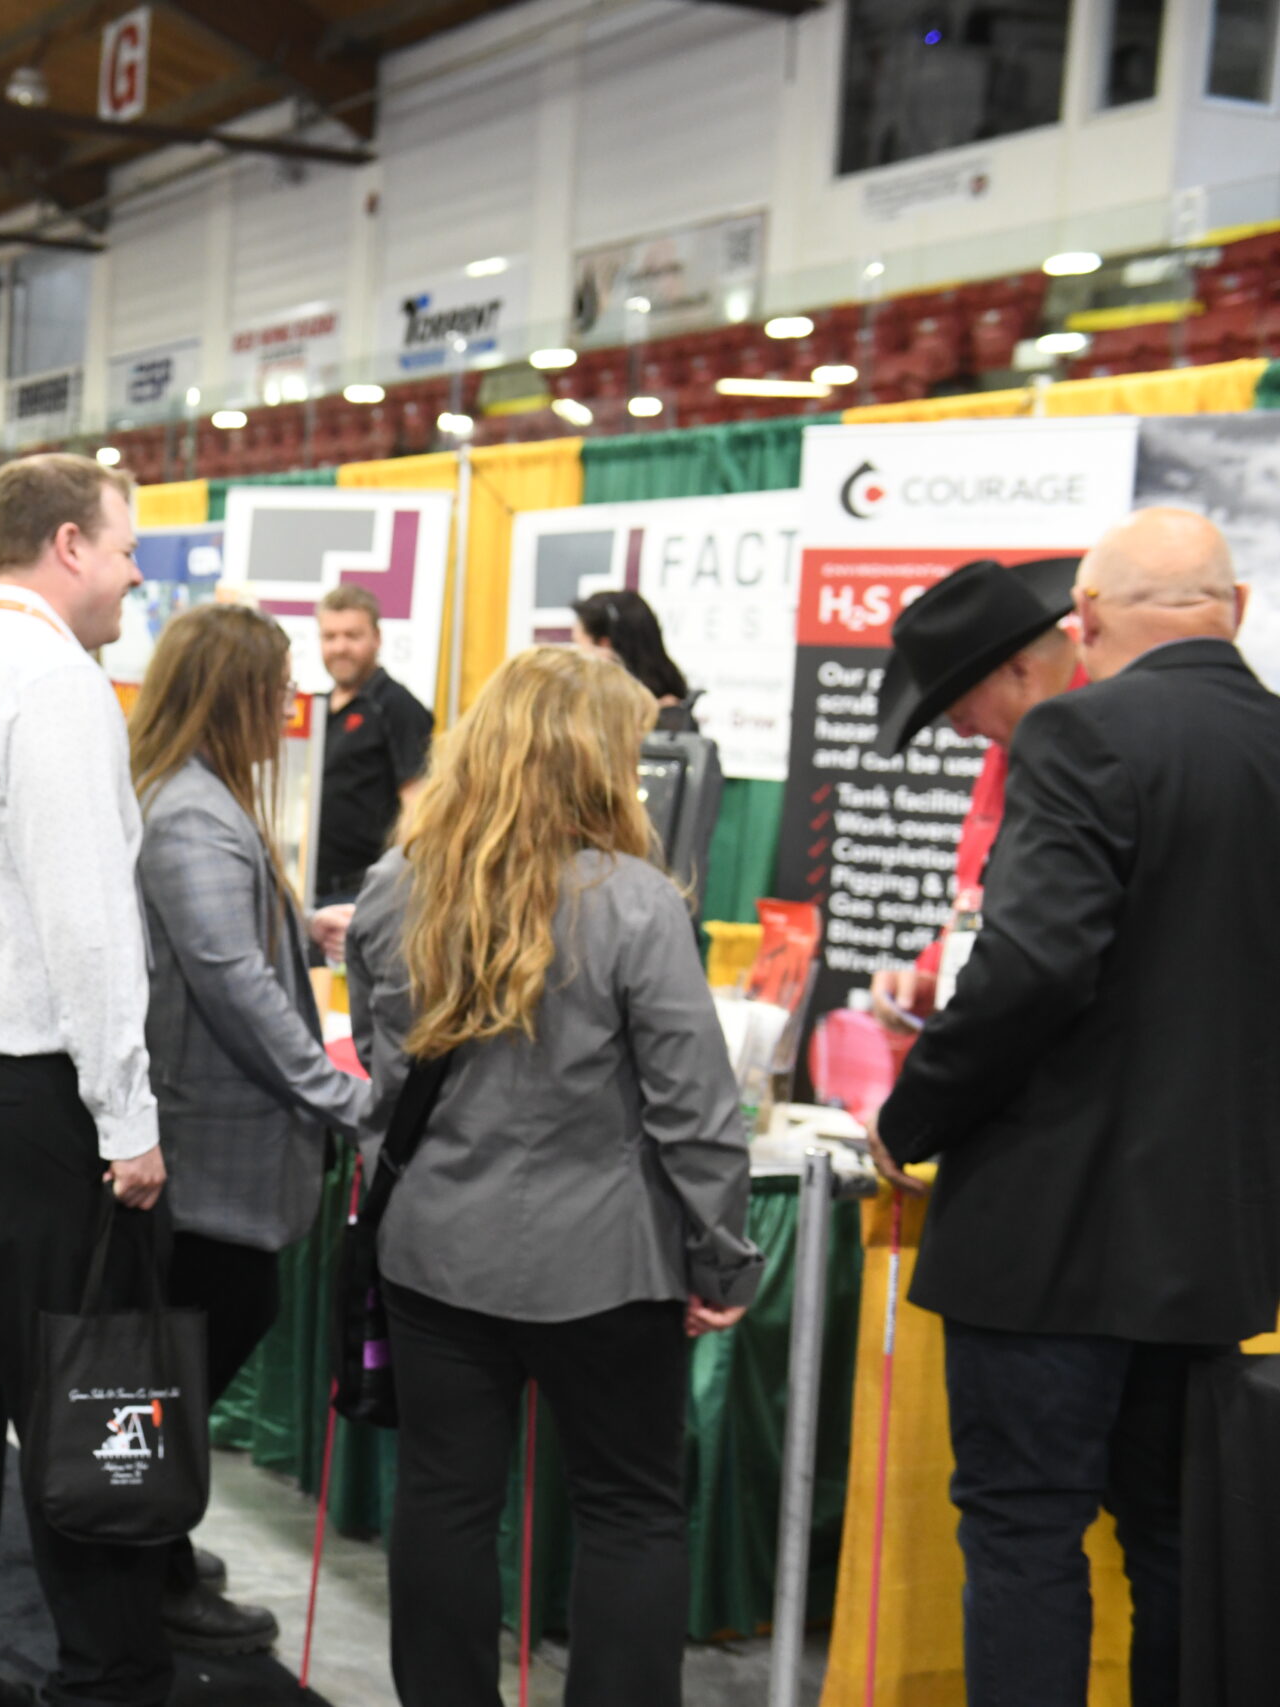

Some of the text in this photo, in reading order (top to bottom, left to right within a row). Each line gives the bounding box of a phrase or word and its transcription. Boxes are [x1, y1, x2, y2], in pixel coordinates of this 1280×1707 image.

[109, 24, 139, 112] G
[901, 474, 1087, 506] COURAGE
[659, 529, 799, 588] FACT
[818, 661, 866, 687] Our
[817, 692, 879, 716] scrub
[813, 746, 860, 769] and
[907, 748, 941, 774] be
[943, 756, 985, 777] use
[837, 782, 973, 815] Tank faciliti
[830, 864, 919, 900] Pigging
[921, 871, 943, 898] &
[828, 891, 954, 926] Gas scrubb
[826, 918, 894, 948] Bleed
